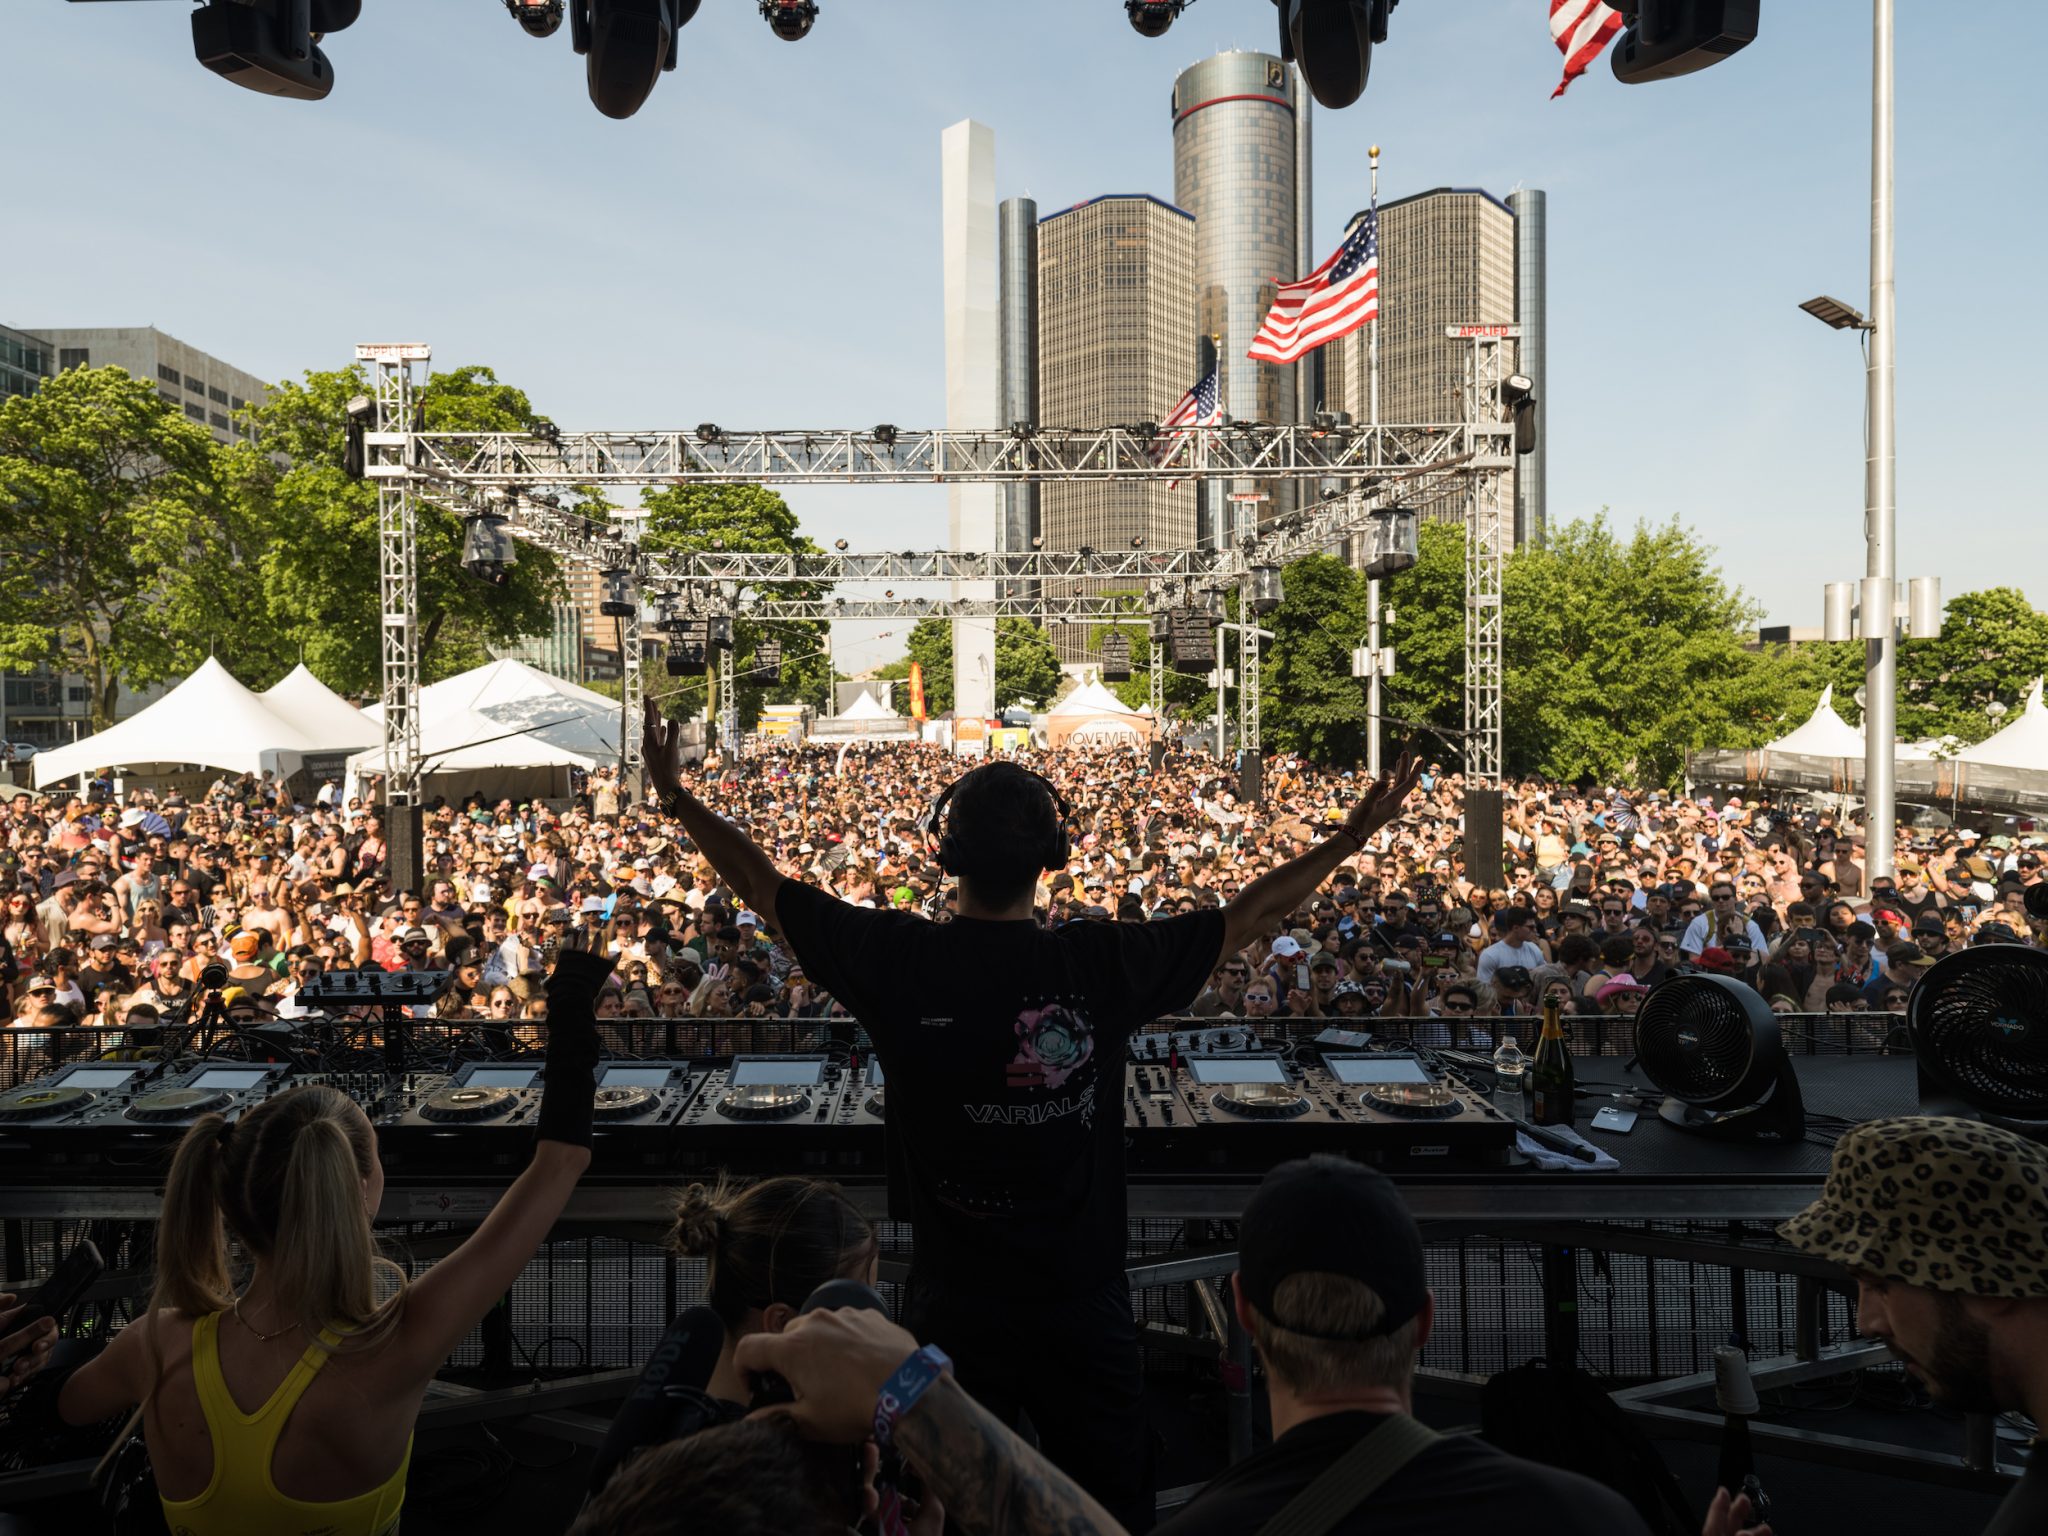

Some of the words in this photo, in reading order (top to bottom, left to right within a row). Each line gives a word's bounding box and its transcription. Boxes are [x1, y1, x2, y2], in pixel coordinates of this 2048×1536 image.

[1459, 325, 1509, 337] APPLIED
[366, 346, 414, 357] APPLIED
[1058, 731, 1148, 746] MOVEMENT
[1990, 1020, 2025, 1031] VORNADO
